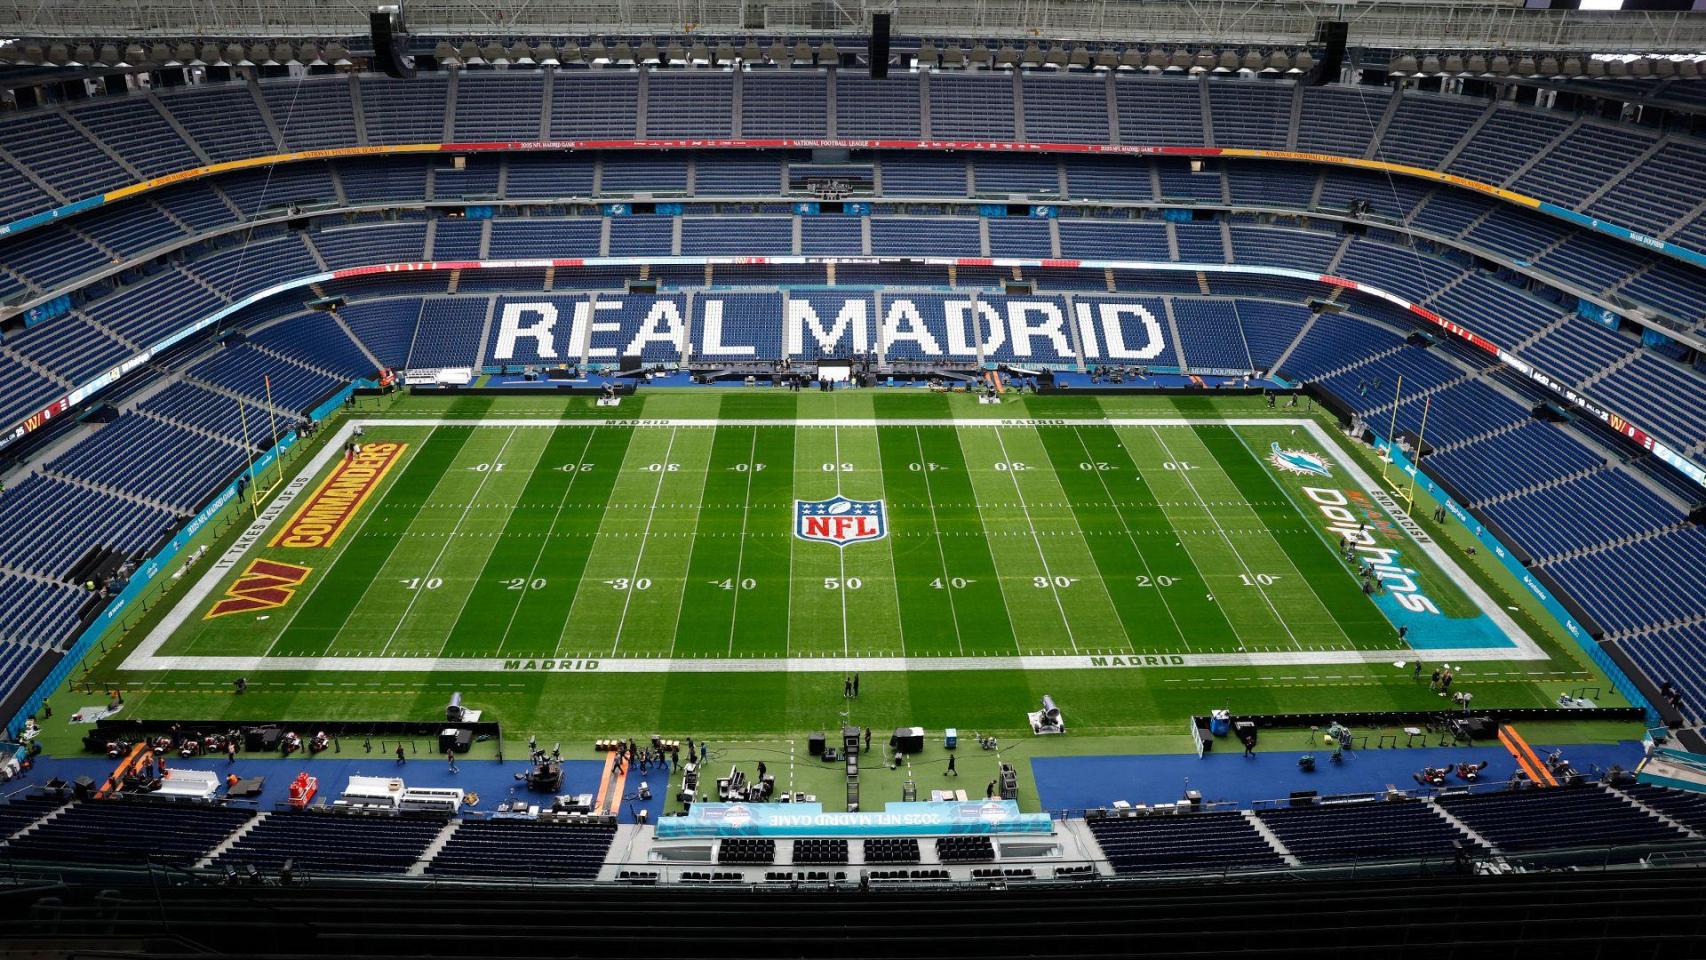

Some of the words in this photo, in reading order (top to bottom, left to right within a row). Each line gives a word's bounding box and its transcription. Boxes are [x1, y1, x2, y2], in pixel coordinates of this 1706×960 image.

[494, 299, 755, 359] REAL
[788, 299, 1166, 359] MADRID
[282, 443, 397, 548] COMMANDERS
[207, 498, 223, 516] MADRID
[215, 559, 234, 568] IT
[228, 524, 266, 554] TAKES
[262, 505, 285, 520] ALL
[278, 492, 294, 500] OF
[290, 478, 308, 488] US
[1371, 491, 1398, 507] END
[1390, 510, 1432, 544] RACISM
[806, 517, 876, 539] NFL
[406, 578, 443, 590] 10
[507, 578, 547, 590] 20
[612, 578, 652, 590] 30
[718, 578, 757, 590] 40
[824, 578, 862, 589] 50
[929, 576, 968, 589] 40
[1033, 575, 1071, 588] 30
[1136, 575, 1173, 587] 20
[1238, 574, 1272, 586] 10
[504, 660, 599, 670] MADRID
[1091, 656, 1184, 666] MADRID
[770, 815, 812, 825] GAME
[815, 814, 871, 825] MADRID
[878, 814, 900, 824] NFL
[904, 814, 940, 824] 2025
